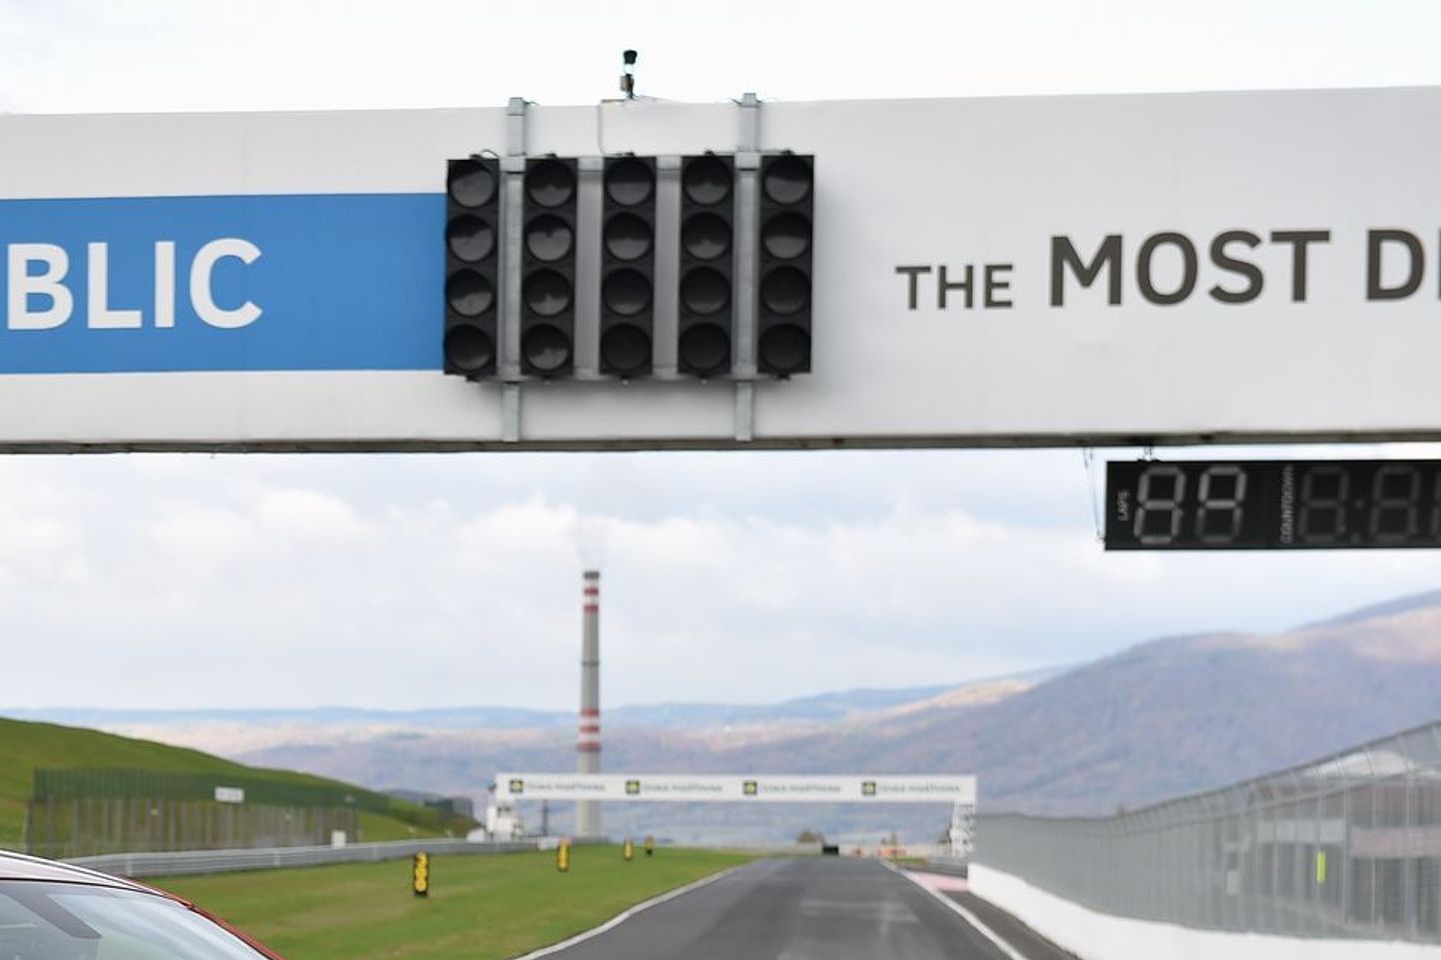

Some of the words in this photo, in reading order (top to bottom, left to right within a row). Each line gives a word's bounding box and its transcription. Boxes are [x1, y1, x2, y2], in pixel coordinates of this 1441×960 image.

[895, 263, 1014, 310] THE
[1049, 229, 1331, 308] MOST
[1366, 228, 1441, 302] D
